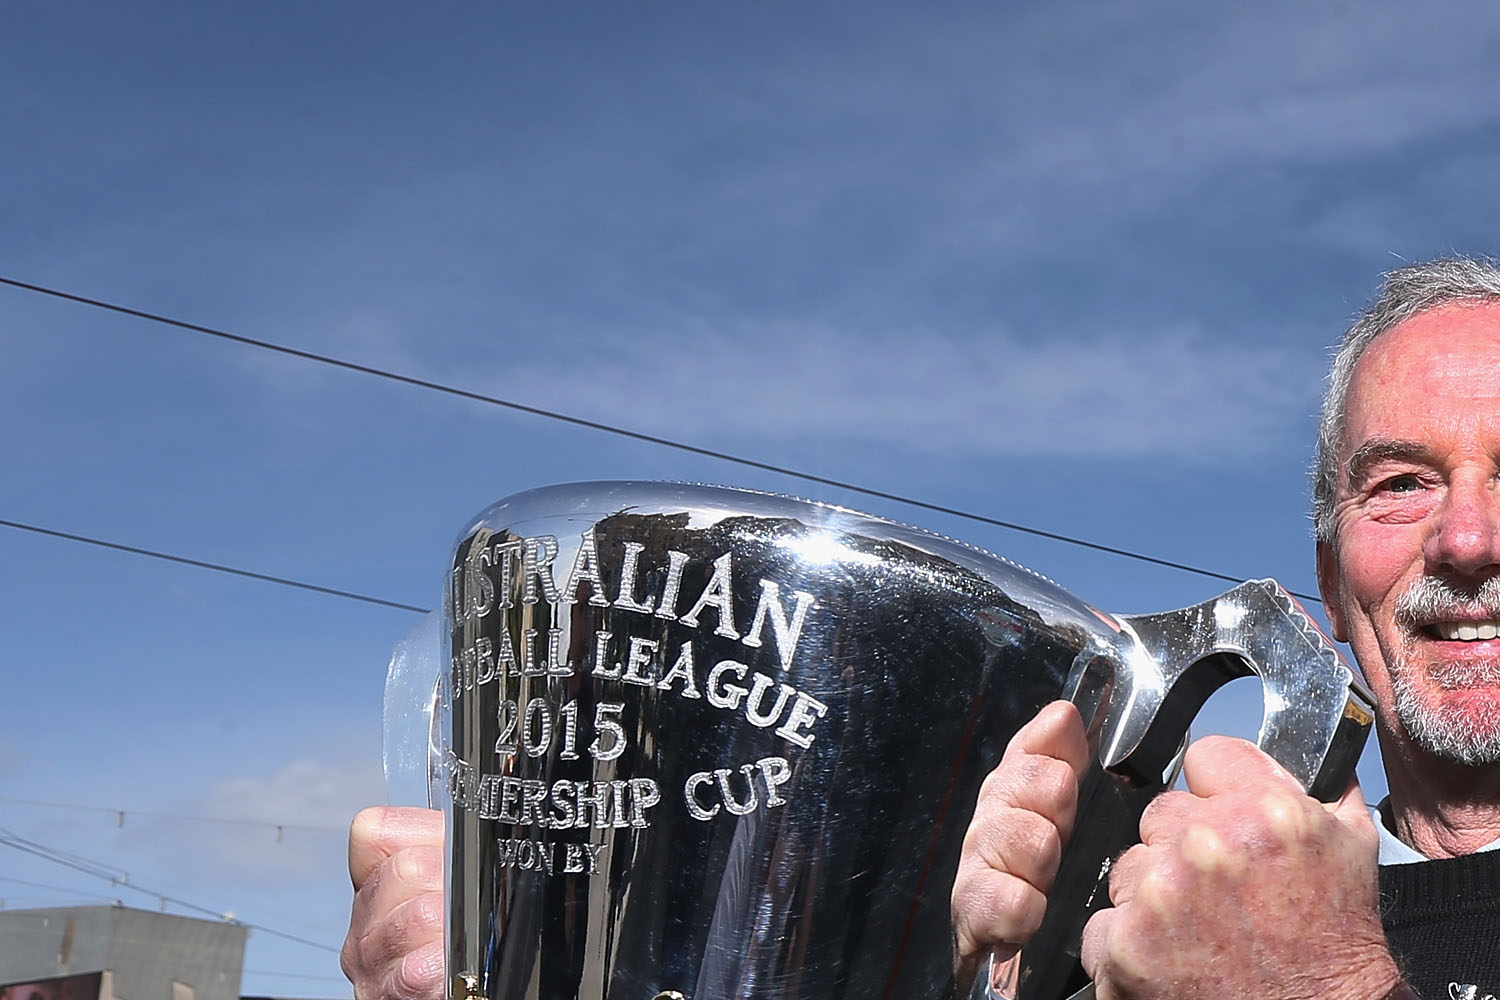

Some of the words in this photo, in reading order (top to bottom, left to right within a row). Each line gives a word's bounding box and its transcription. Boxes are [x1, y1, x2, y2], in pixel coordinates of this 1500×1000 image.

[591, 630, 829, 750] LEAGUE
[494, 697, 628, 763] 2015
[684, 757, 792, 821] CUP
[498, 838, 555, 878] WON
[562, 838, 608, 876] BY
